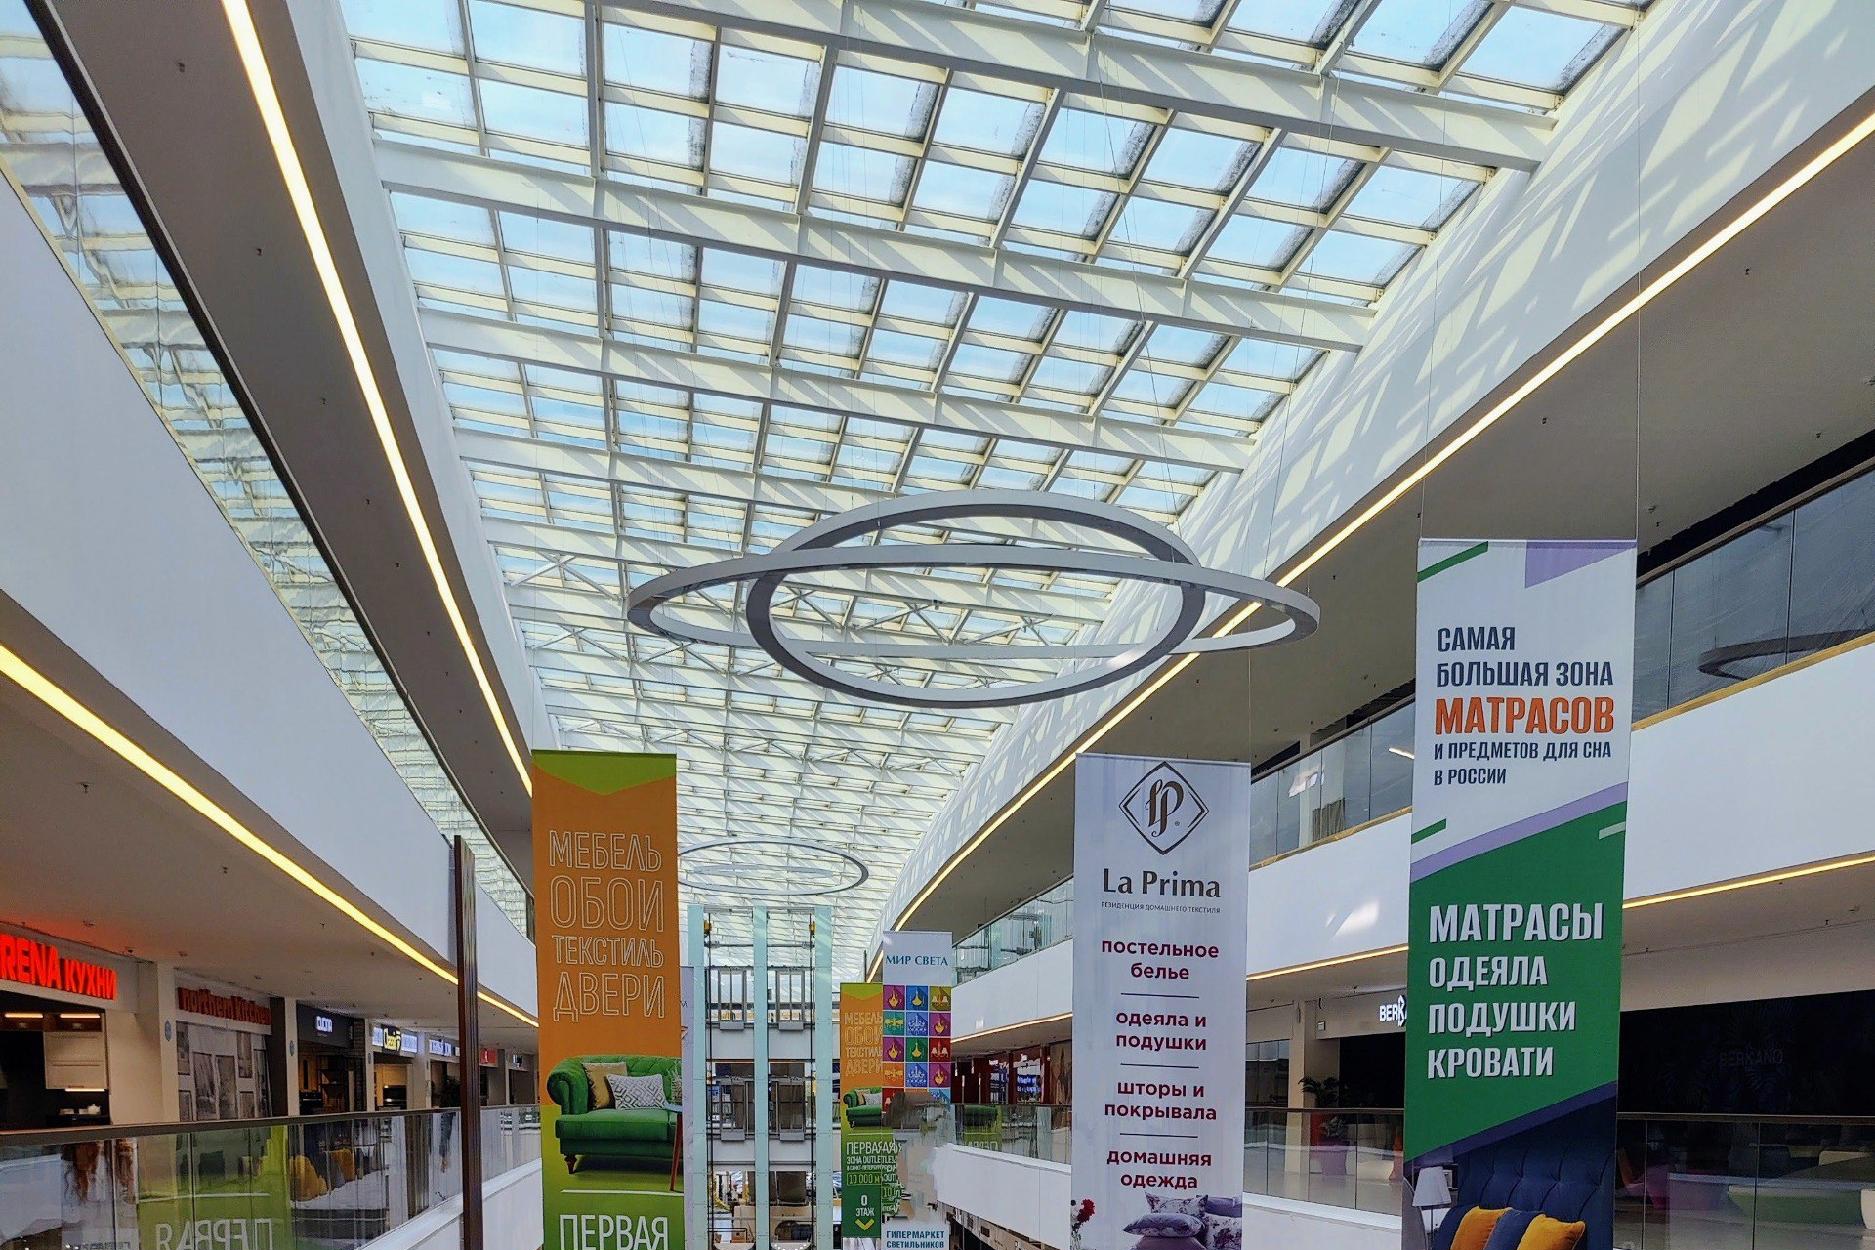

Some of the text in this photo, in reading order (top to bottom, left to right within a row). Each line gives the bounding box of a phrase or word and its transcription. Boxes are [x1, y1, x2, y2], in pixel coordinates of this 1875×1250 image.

[1437, 626, 1516, 652] САМАЯ
[1436, 661, 1613, 688] БОЛЬШАЯ ЗОНА
[1434, 696, 1614, 735] МАТРАСОВ
[1434, 741, 1612, 762] И ПРЕДМЕТОВ ДЛЯ СНА
[1434, 768, 1507, 785] В РОССИИ
[549, 830, 662, 872] МЕБЕЛЬ
[1103, 868, 1221, 898] La Prima
[550, 875, 664, 932] ОБОИ
[1429, 902, 1604, 943] МАТРАСЫ
[551, 935, 664, 968] ТЕКСТИЛЬ
[1102, 939, 1220, 958] постельное
[885, 955, 948, 966] МИР СВЕТА
[1130, 963, 1190, 980] белье
[64, 958, 117, 1001] КУХНИ
[1429, 955, 1548, 992] ОДЕЯЛА
[553, 972, 665, 1022] ДВЕРИ
[1115, 1011, 1207, 1028] одеяла и
[1379, 995, 1408, 1027] BERK
[1428, 1001, 1576, 1038] ПОДУШКИ
[1115, 1034, 1207, 1052] подушки
[1427, 1047, 1554, 1079] КРОВАТИ
[1117, 1081, 1204, 1099] шторы и
[1104, 1103, 1217, 1121] покрывала
[1106, 1150, 1212, 1167] домашняя
[1120, 1173, 1198, 1190] одежда
[855, 1208, 875, 1217] ЭТАЖ
[886, 1230, 945, 1239] ГИПЕРМАРКЕТ
[886, 1241, 945, 1249] СВЕТИЛЬНИКОВ
